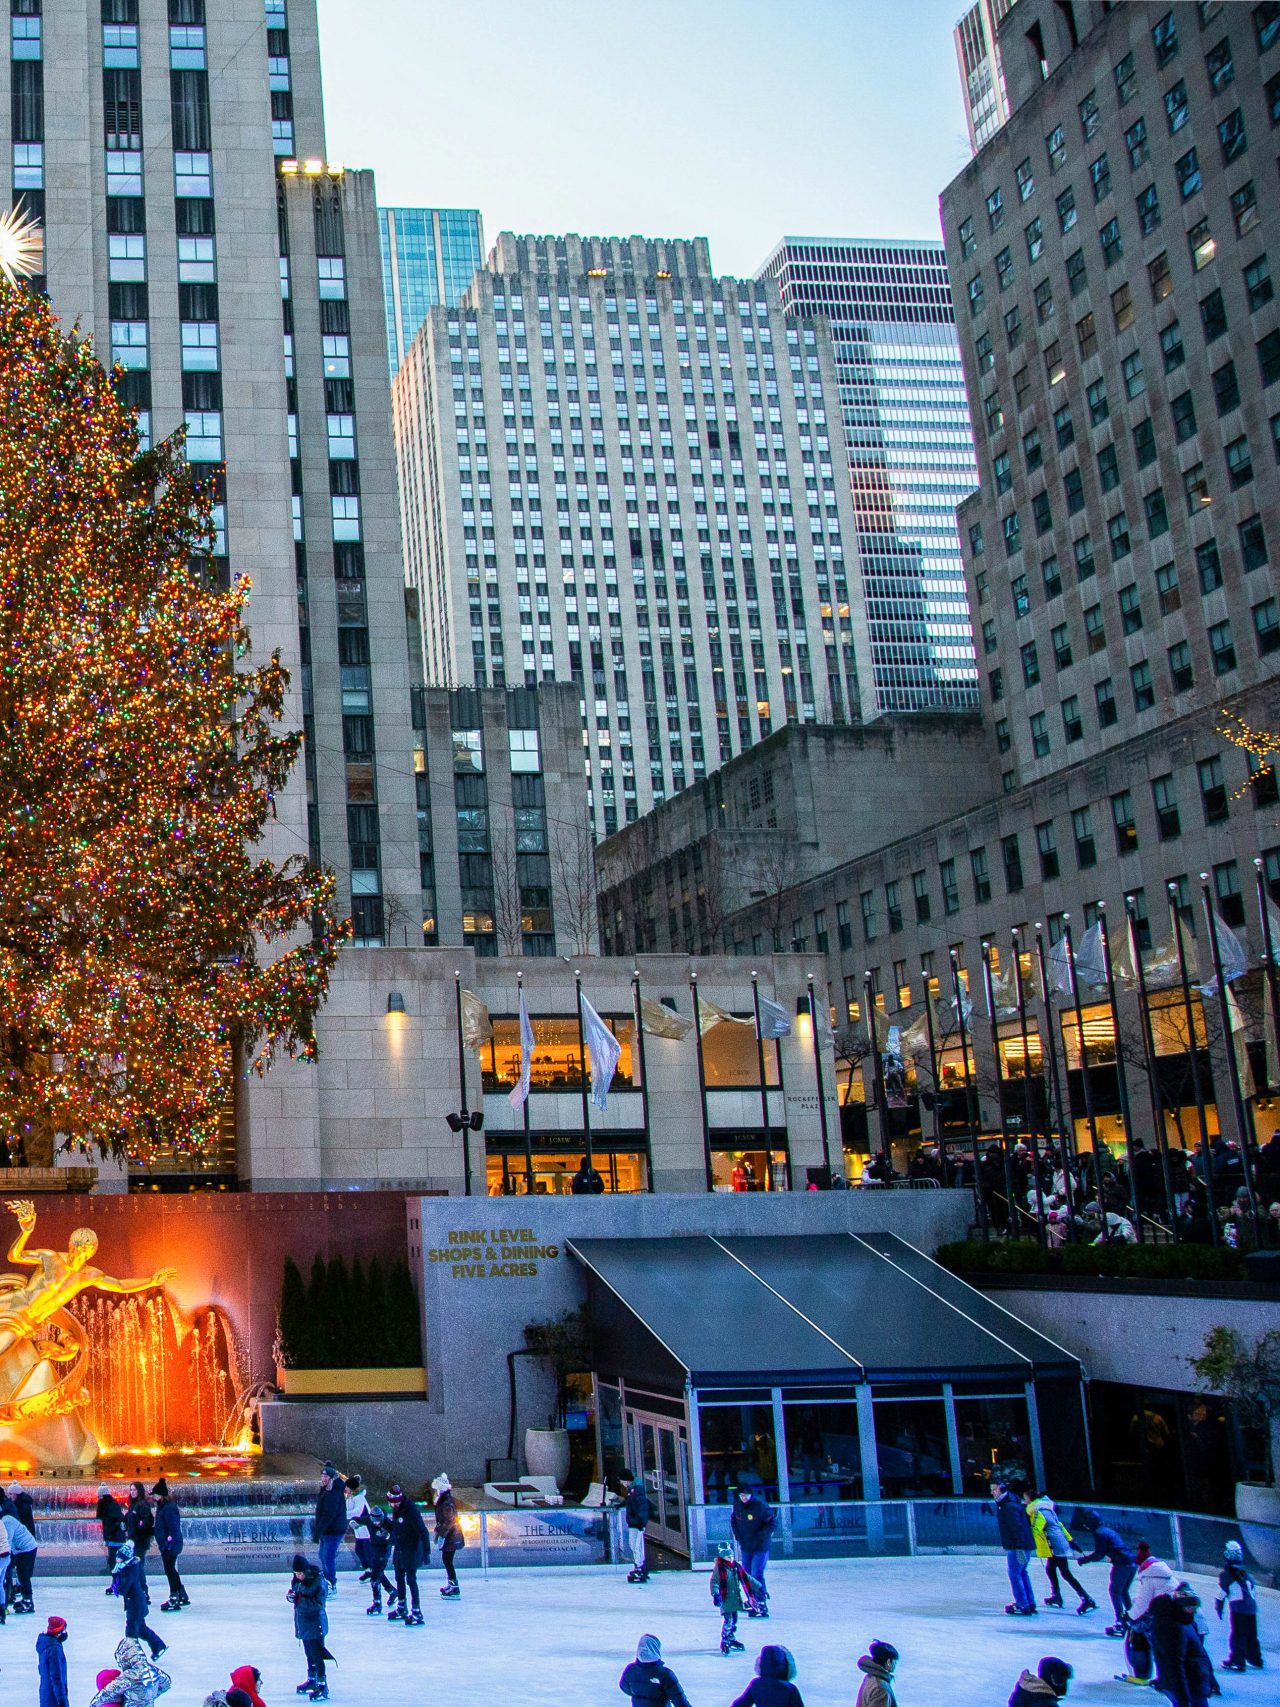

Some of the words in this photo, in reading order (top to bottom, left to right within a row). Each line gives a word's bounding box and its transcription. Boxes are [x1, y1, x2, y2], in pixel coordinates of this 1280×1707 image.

[448, 1230, 488, 1244] RINK
[490, 1228, 537, 1243] LEVEL
[429, 1247, 481, 1262] SHOPS
[486, 1246, 497, 1260] &
[501, 1245, 559, 1260] DINING
[452, 1264, 486, 1279] FIVE
[489, 1263, 537, 1278] ACRES
[227, 1532, 247, 1543] THE
[252, 1531, 278, 1542] RINK
[524, 1525, 544, 1536] THE
[549, 1524, 574, 1536] RINK
